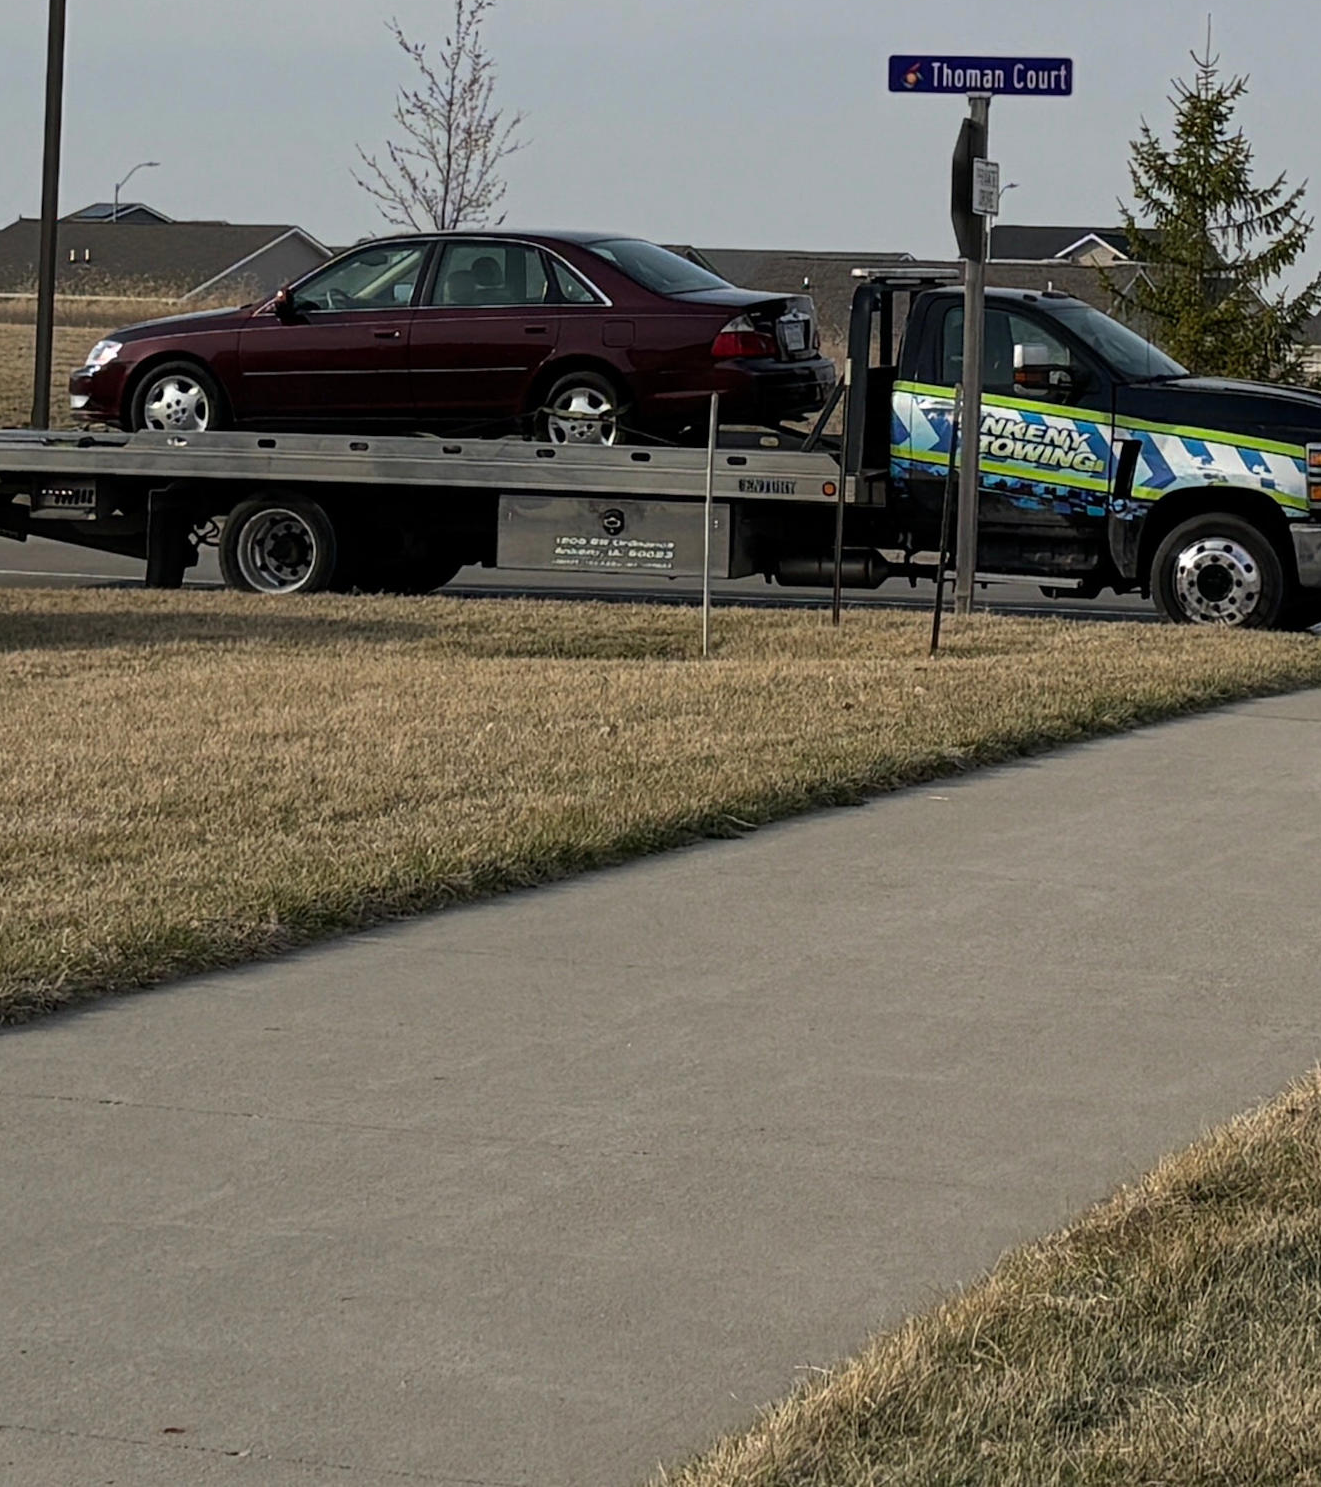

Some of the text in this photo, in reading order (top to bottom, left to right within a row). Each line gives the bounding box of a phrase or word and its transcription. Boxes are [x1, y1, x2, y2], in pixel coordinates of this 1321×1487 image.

[932, 62, 1067, 90] Thoman Court
[980, 416, 1090, 450] NKENY
